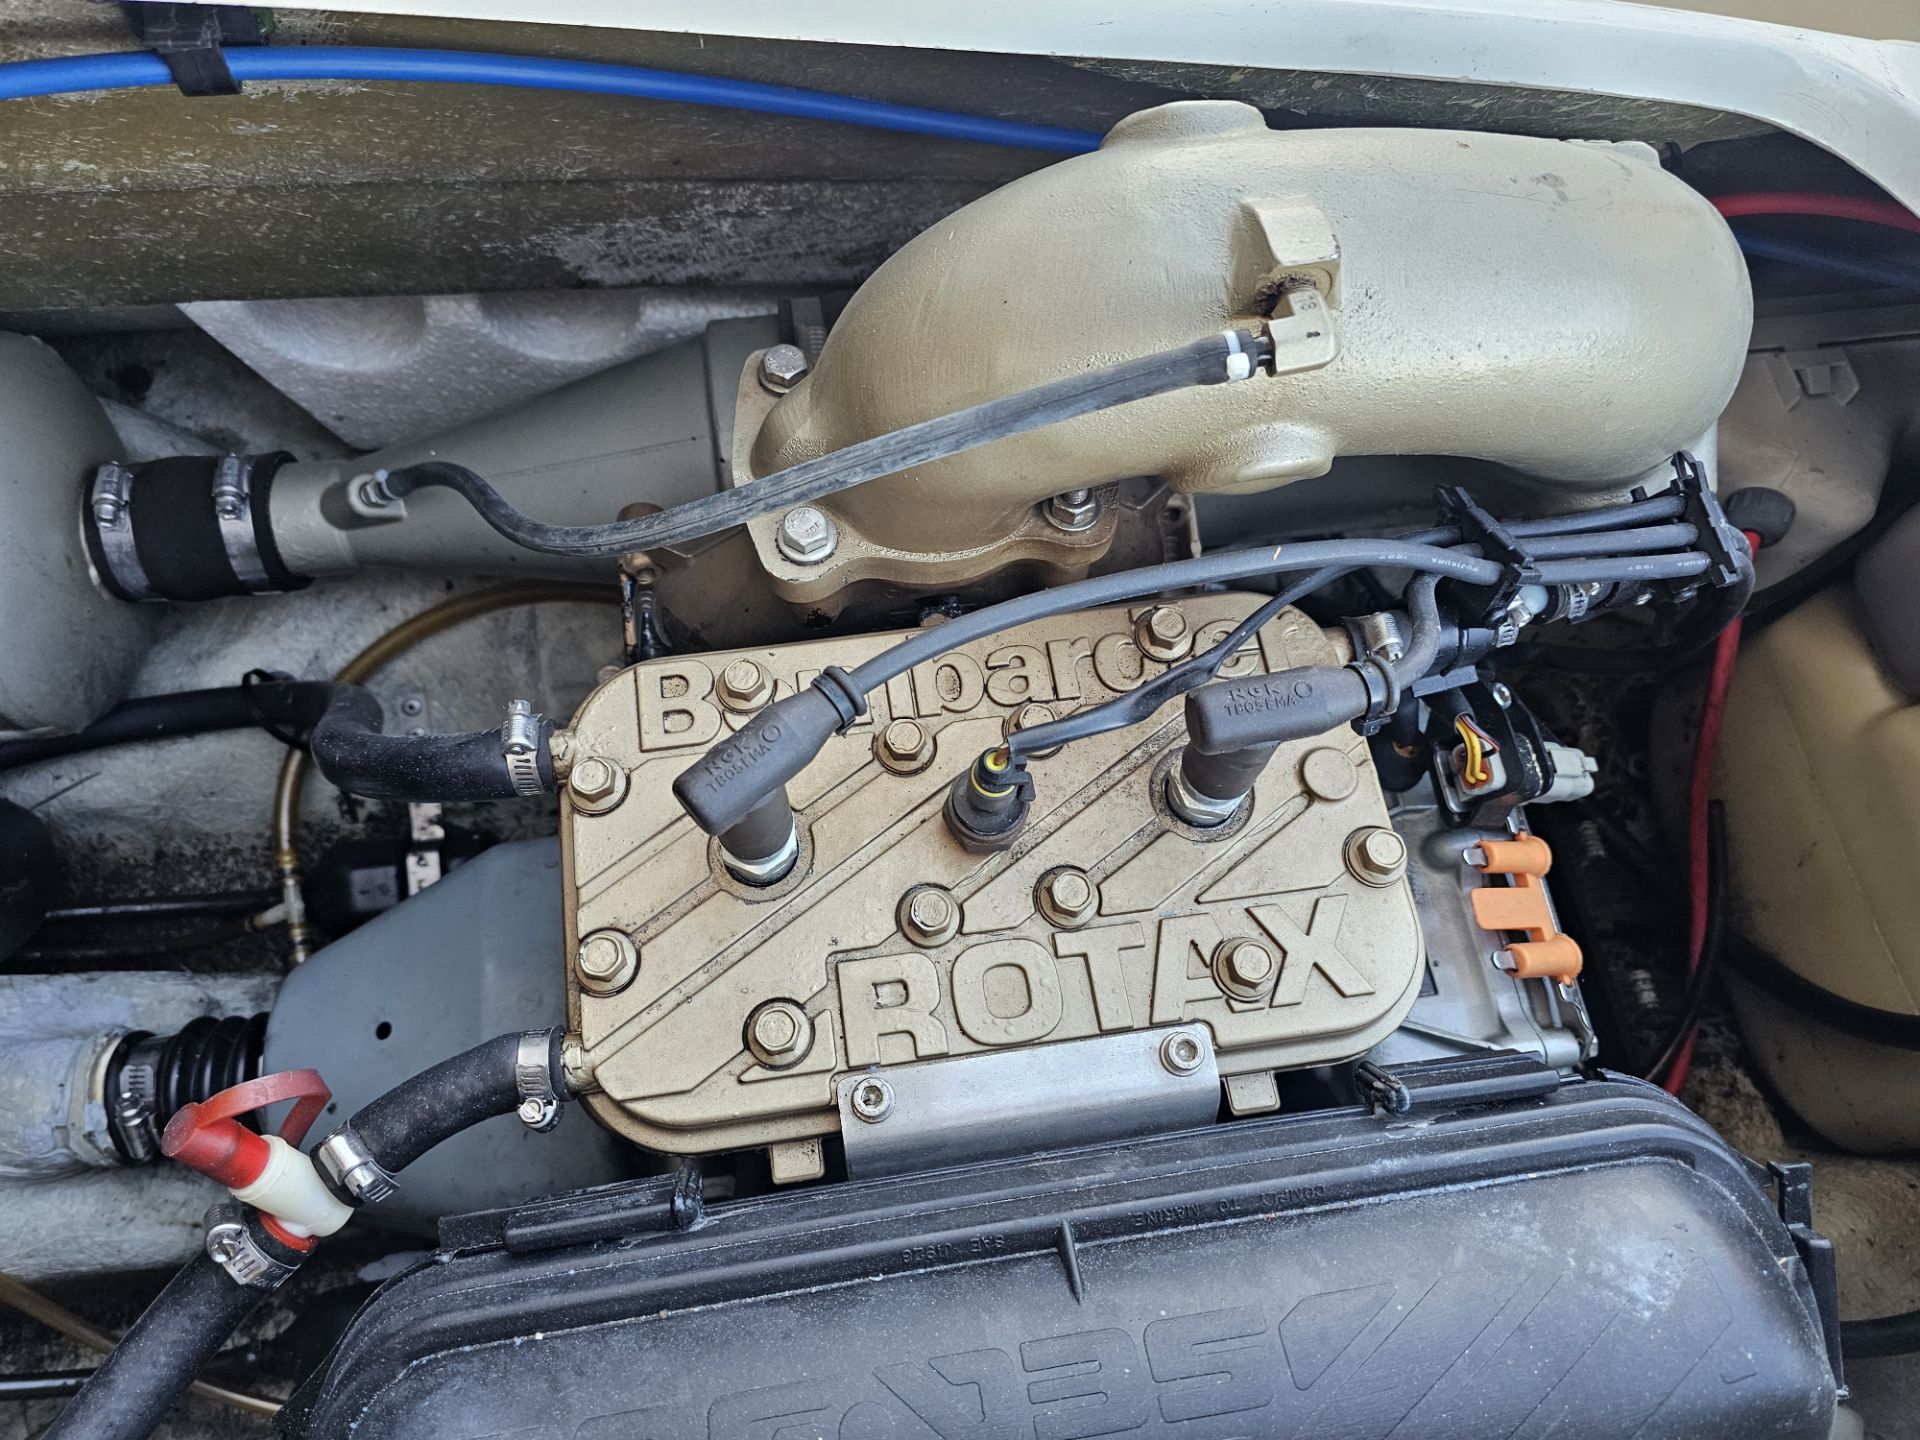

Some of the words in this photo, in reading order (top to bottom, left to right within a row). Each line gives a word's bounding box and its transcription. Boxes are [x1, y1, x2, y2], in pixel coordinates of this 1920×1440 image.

[1430, 556, 1479, 573] FUJIKURA
[1228, 680, 1281, 702] NGK
[836, 893, 1377, 1068] ROTAX
[969, 1233, 1005, 1253] SAE
